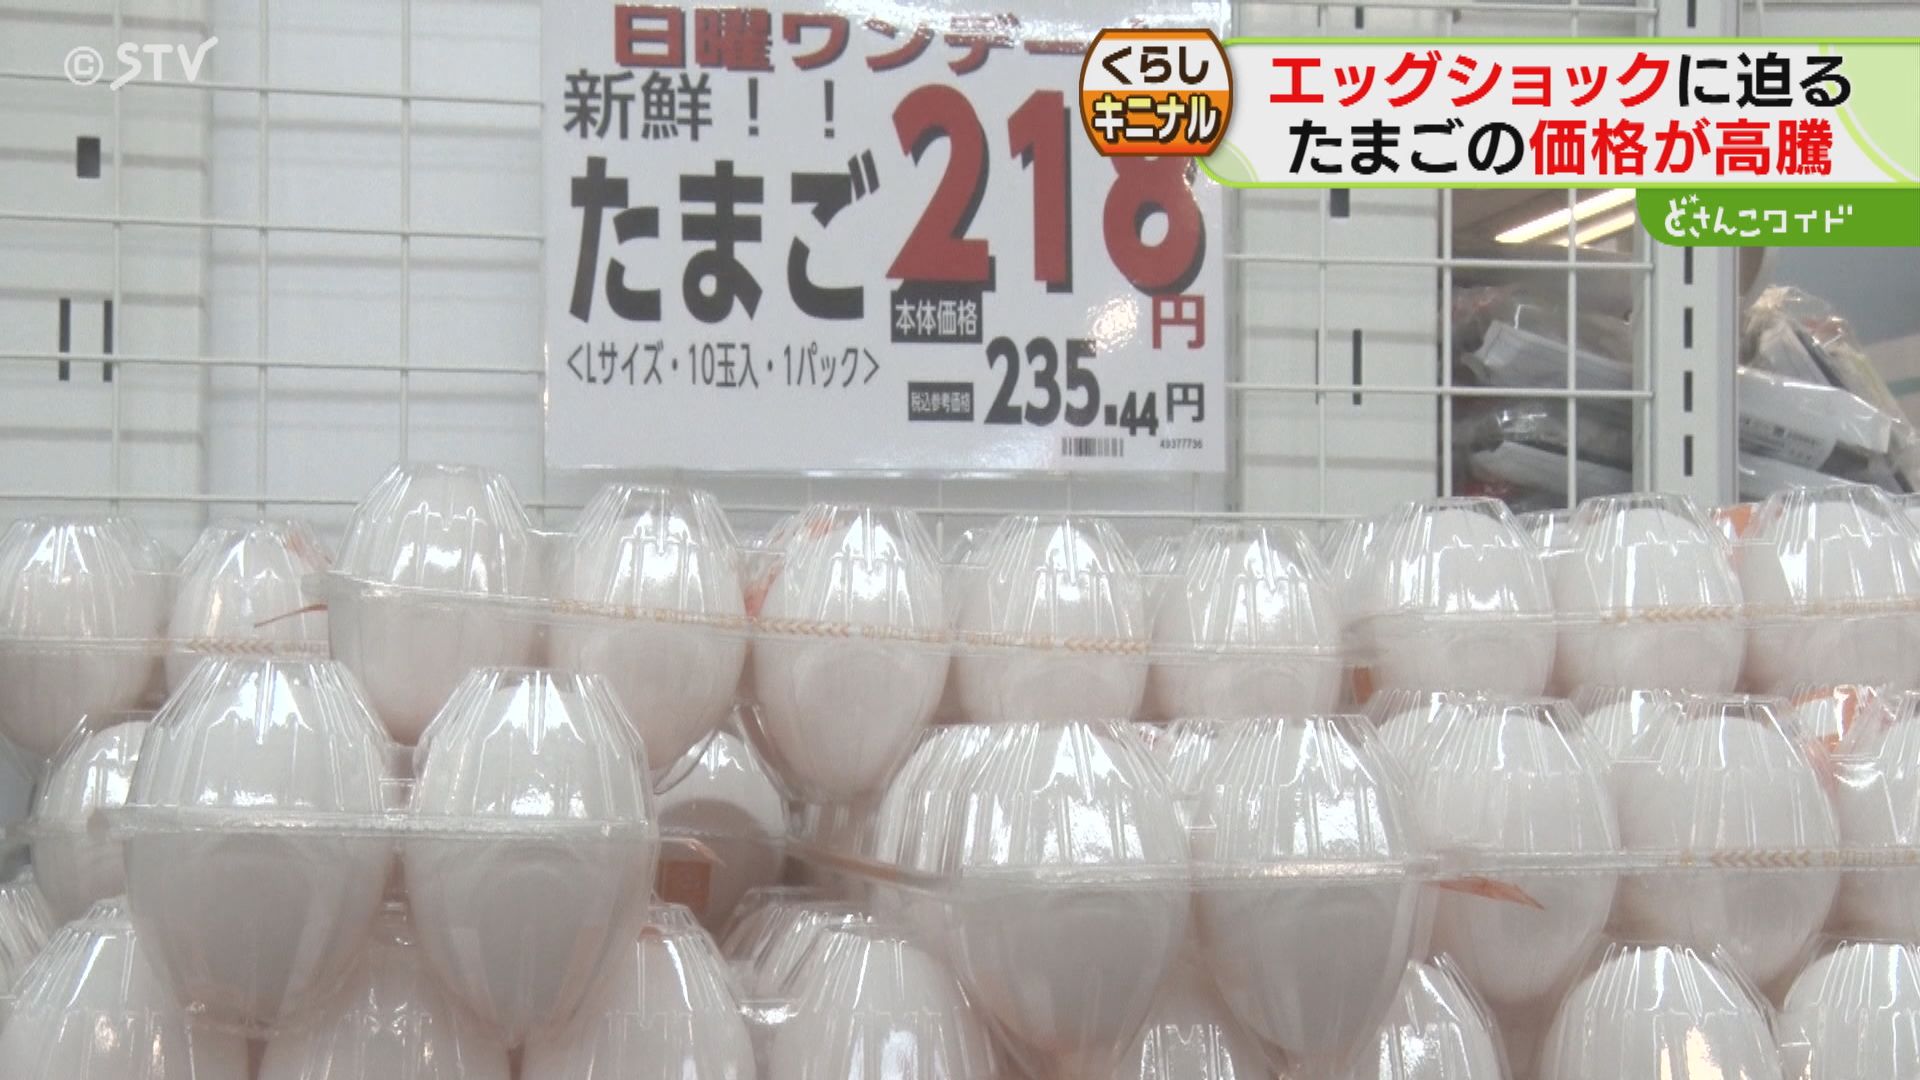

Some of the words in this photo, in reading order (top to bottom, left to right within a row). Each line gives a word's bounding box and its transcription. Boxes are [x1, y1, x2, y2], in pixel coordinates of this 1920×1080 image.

[614, 4, 1146, 76] 日曜ワンデー
[885, 83, 1206, 297] 218
[569, 148, 880, 323] たまご
[895, 299, 978, 336] 本体価格
[1151, 294, 1206, 350] 円
